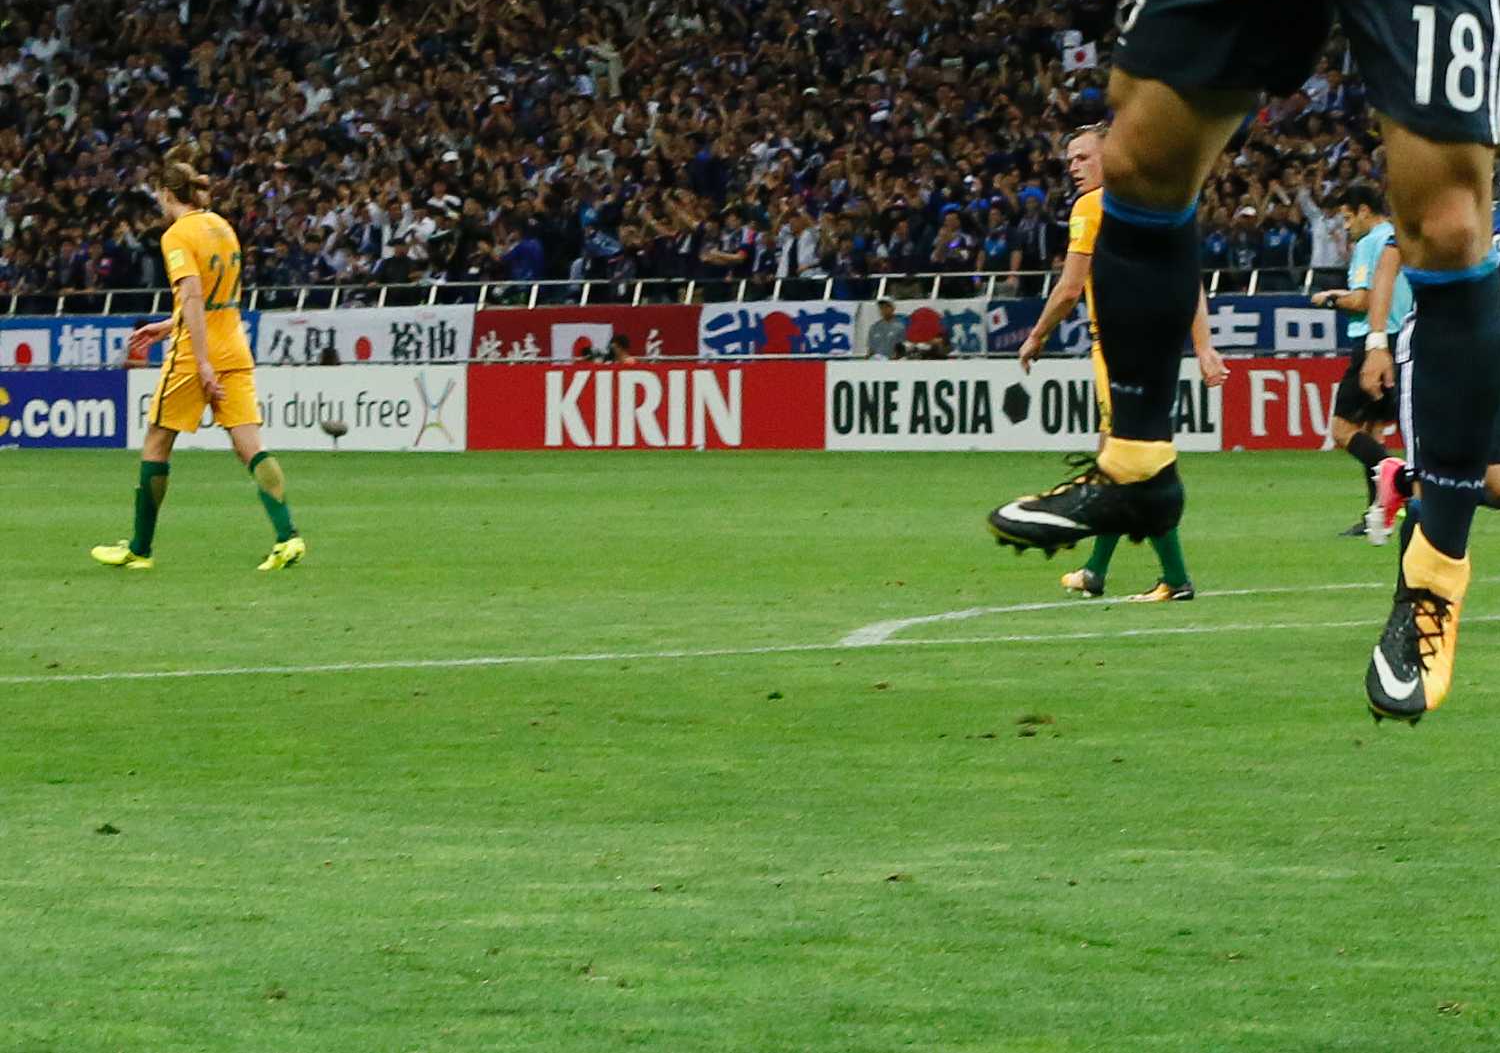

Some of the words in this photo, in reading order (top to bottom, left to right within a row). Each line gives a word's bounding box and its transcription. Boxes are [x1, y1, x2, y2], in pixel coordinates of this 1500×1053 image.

[1412, 4, 1486, 113] 18
[354, 390, 412, 429] free
[544, 368, 743, 447] KIRIN
[833, 380, 899, 435] ONE
[909, 379, 994, 435] ASIA
[1248, 369, 1341, 451] Fly
